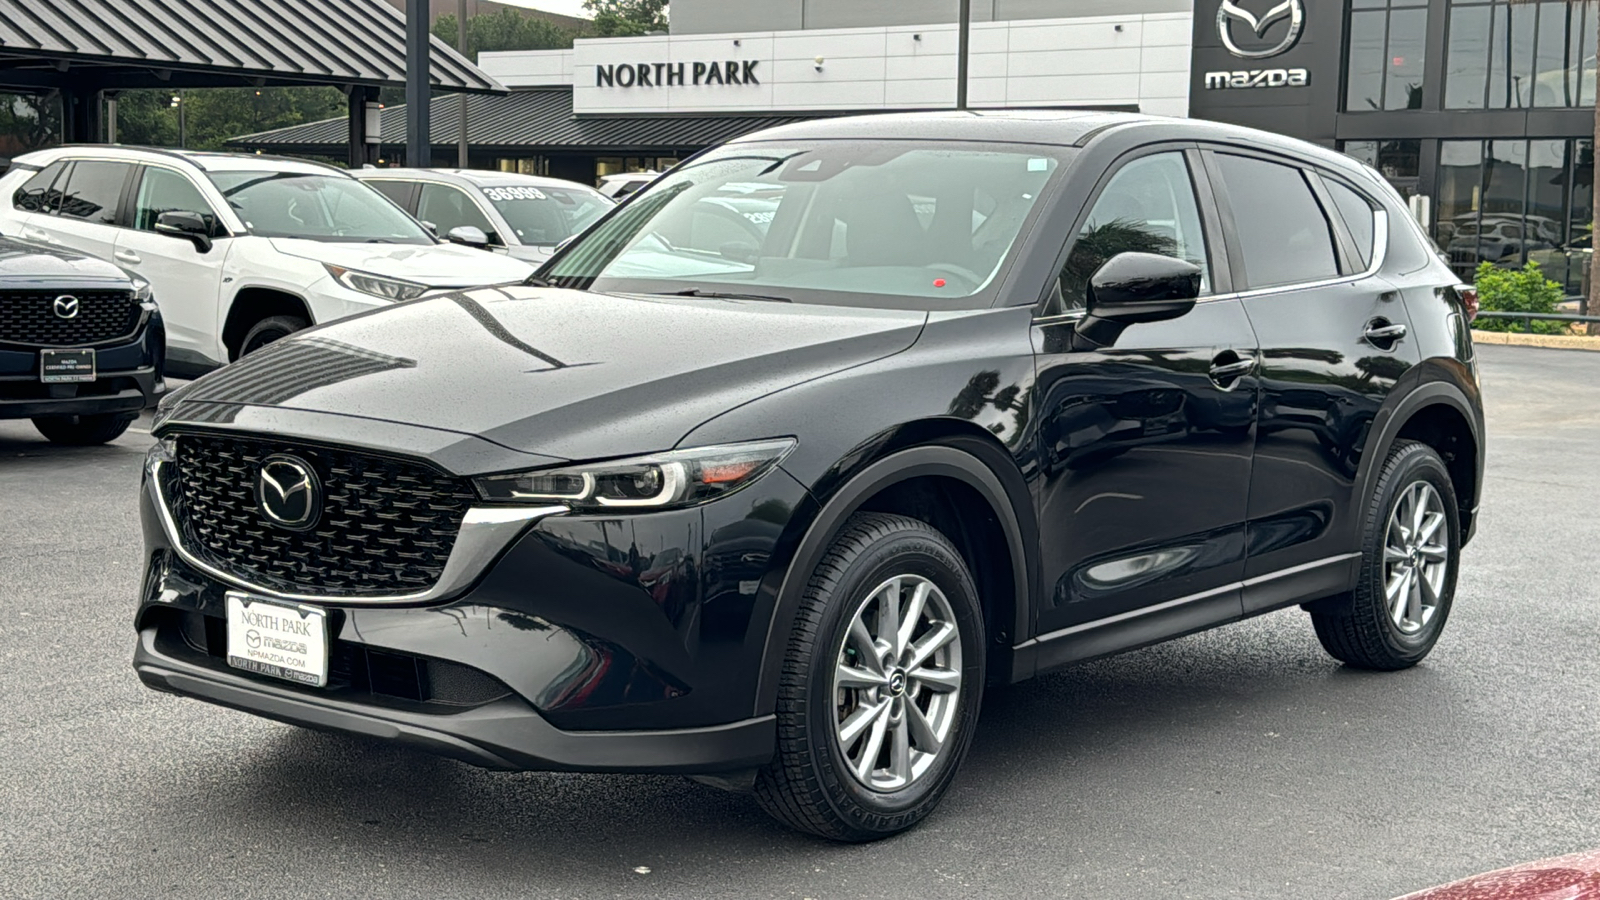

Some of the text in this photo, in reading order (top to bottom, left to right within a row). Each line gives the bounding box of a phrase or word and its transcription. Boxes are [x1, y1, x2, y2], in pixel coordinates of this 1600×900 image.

[596, 60, 760, 88] NORTH PARK
[1204, 68, 1309, 89] mazda
[483, 186, 546, 201] 36999
[241, 609, 311, 637] NORTH PARK
[263, 635, 308, 655] mazda
[231, 656, 258, 672] NORTH
[260, 663, 282, 677] PARK
